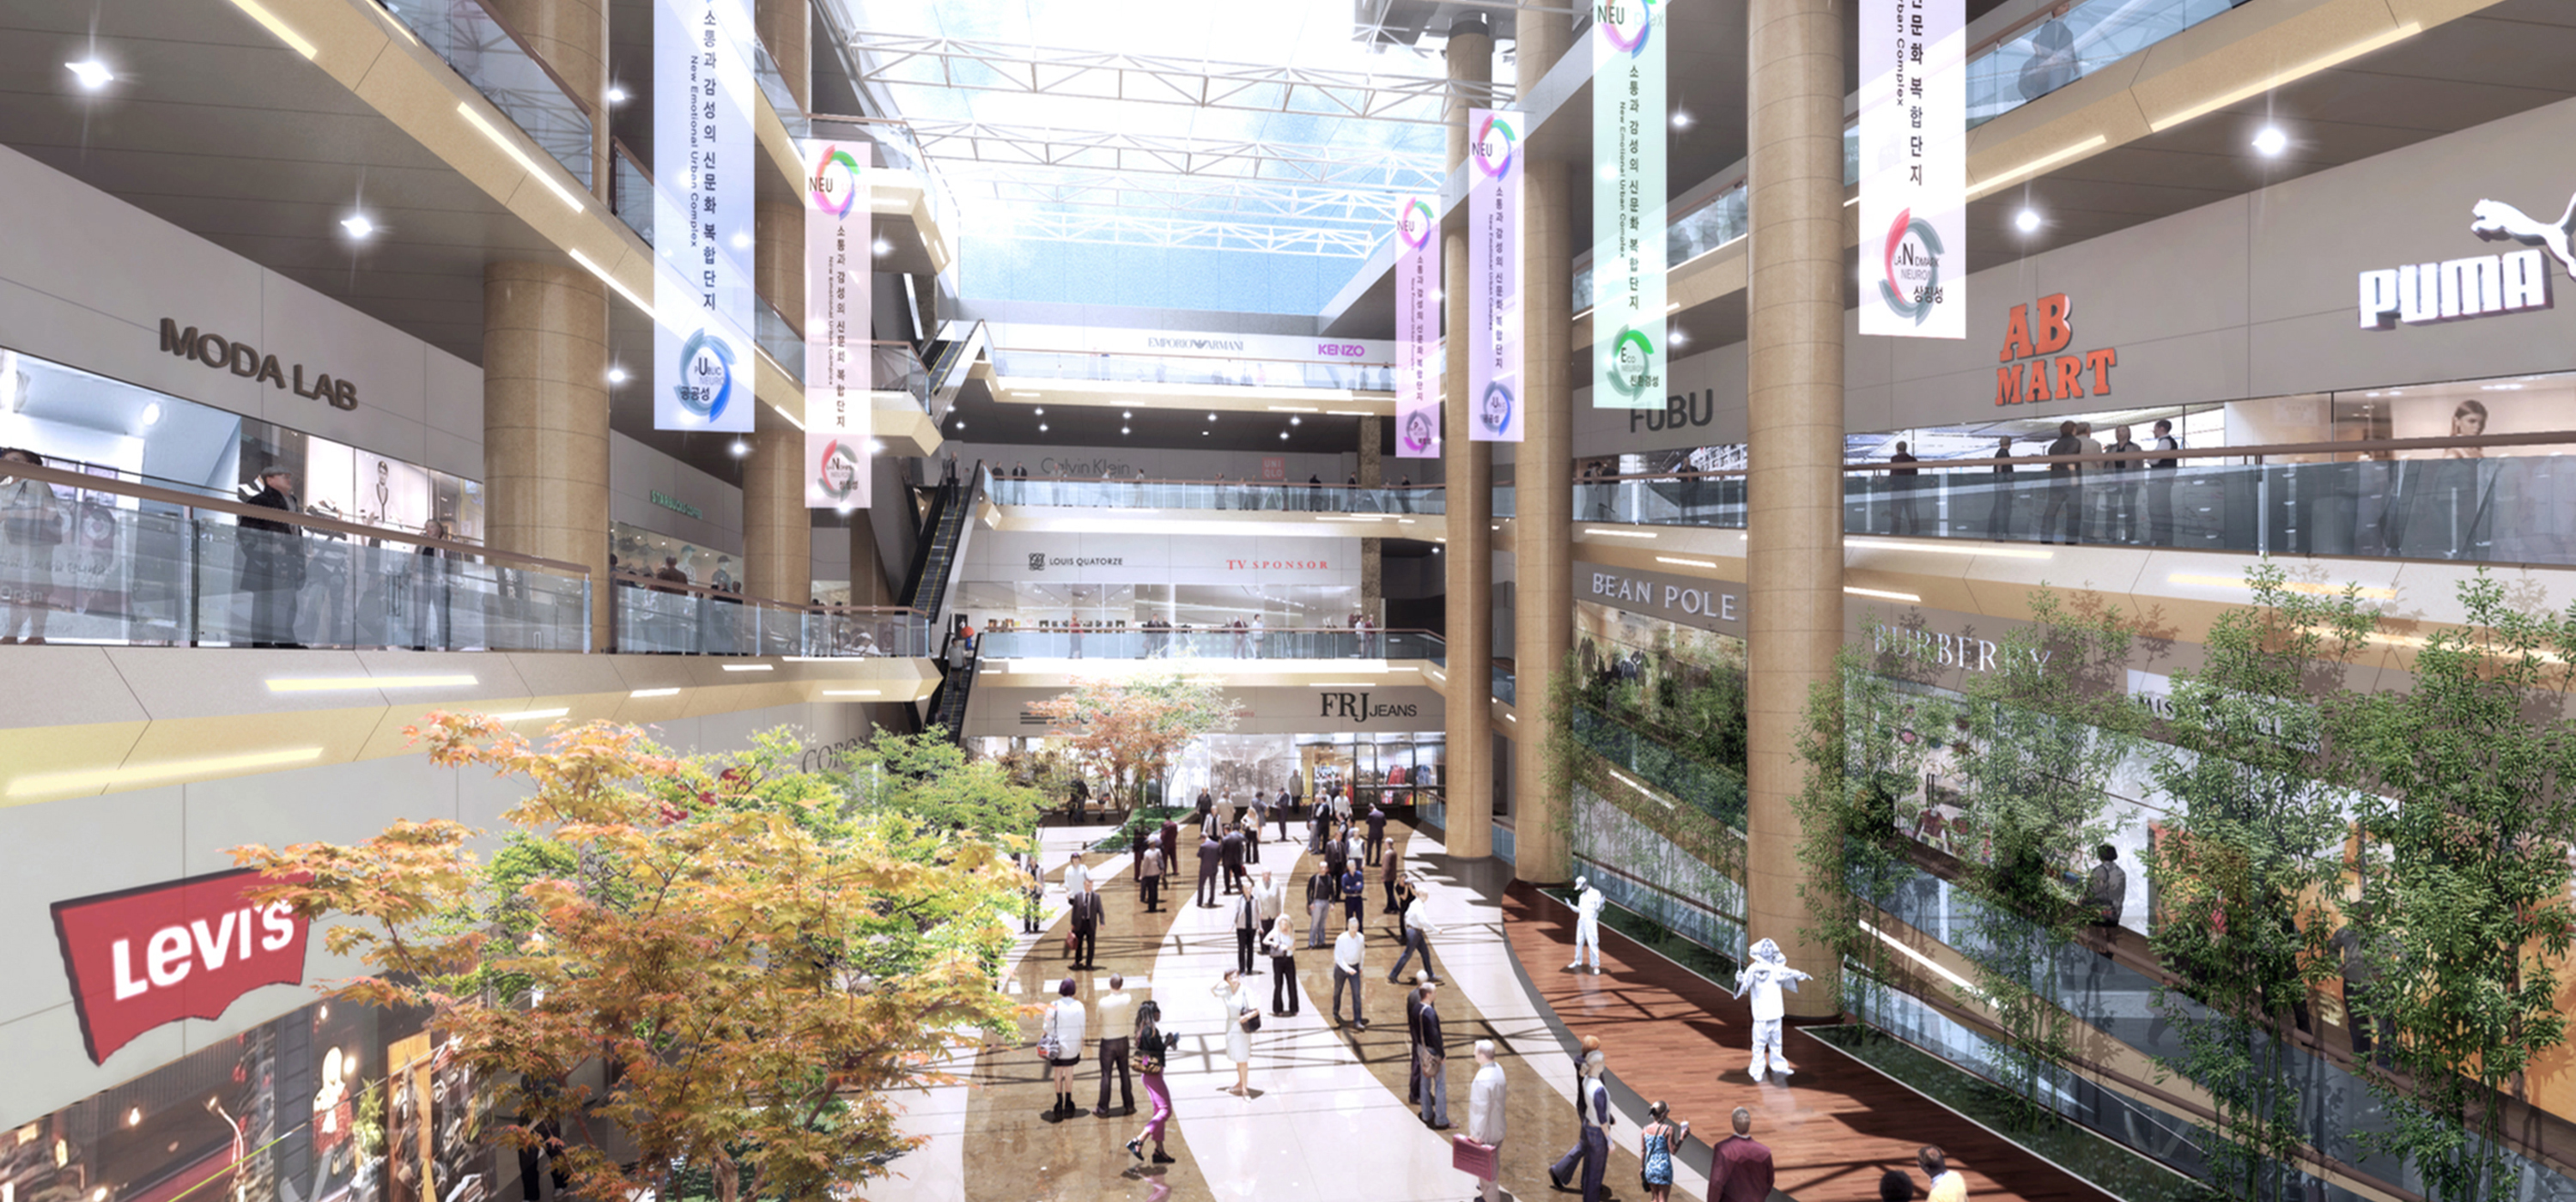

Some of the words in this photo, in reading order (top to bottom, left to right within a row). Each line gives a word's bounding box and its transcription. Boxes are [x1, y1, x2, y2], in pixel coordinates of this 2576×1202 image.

[1597, 4, 1625, 25] NEU
[703, 10, 717, 69] 소통과
[690, 55, 699, 82] New
[1896, 38, 1905, 106] Complex
[690, 86, 699, 147] Emotional
[703, 78, 717, 143] 감성의
[1910, 77, 1923, 186] 복합단지
[690, 151, 699, 189] Urban
[1472, 143, 1493, 157] NEU
[703, 152, 717, 214] 신문화
[809, 177, 833, 192] NEU
[690, 192, 699, 247] Complex
[703, 223, 717, 310] 복합단지
[2359, 249, 2551, 331] PUMA
[1318, 343, 1365, 357] KENZO
[2000, 292, 2073, 364] AB
[160, 317, 287, 389] MODA
[293, 363, 358, 411] LAB
[1995, 347, 2117, 406] MART
[1630, 388, 1714, 433] FUBU
[1093, 458, 1131, 475] Klein
[1264, 459, 1281, 468] UNI
[1049, 557, 1074, 566] LOUIS
[1076, 557, 1123, 567] QUATORZE
[1225, 559, 1247, 570] TV
[1252, 560, 1328, 570] SPONSOR
[1592, 573, 1654, 604] BEAN
[1664, 585, 1739, 622] POLE
[1320, 692, 1370, 723] FRJ
[1369, 704, 1418, 717] JEANS
